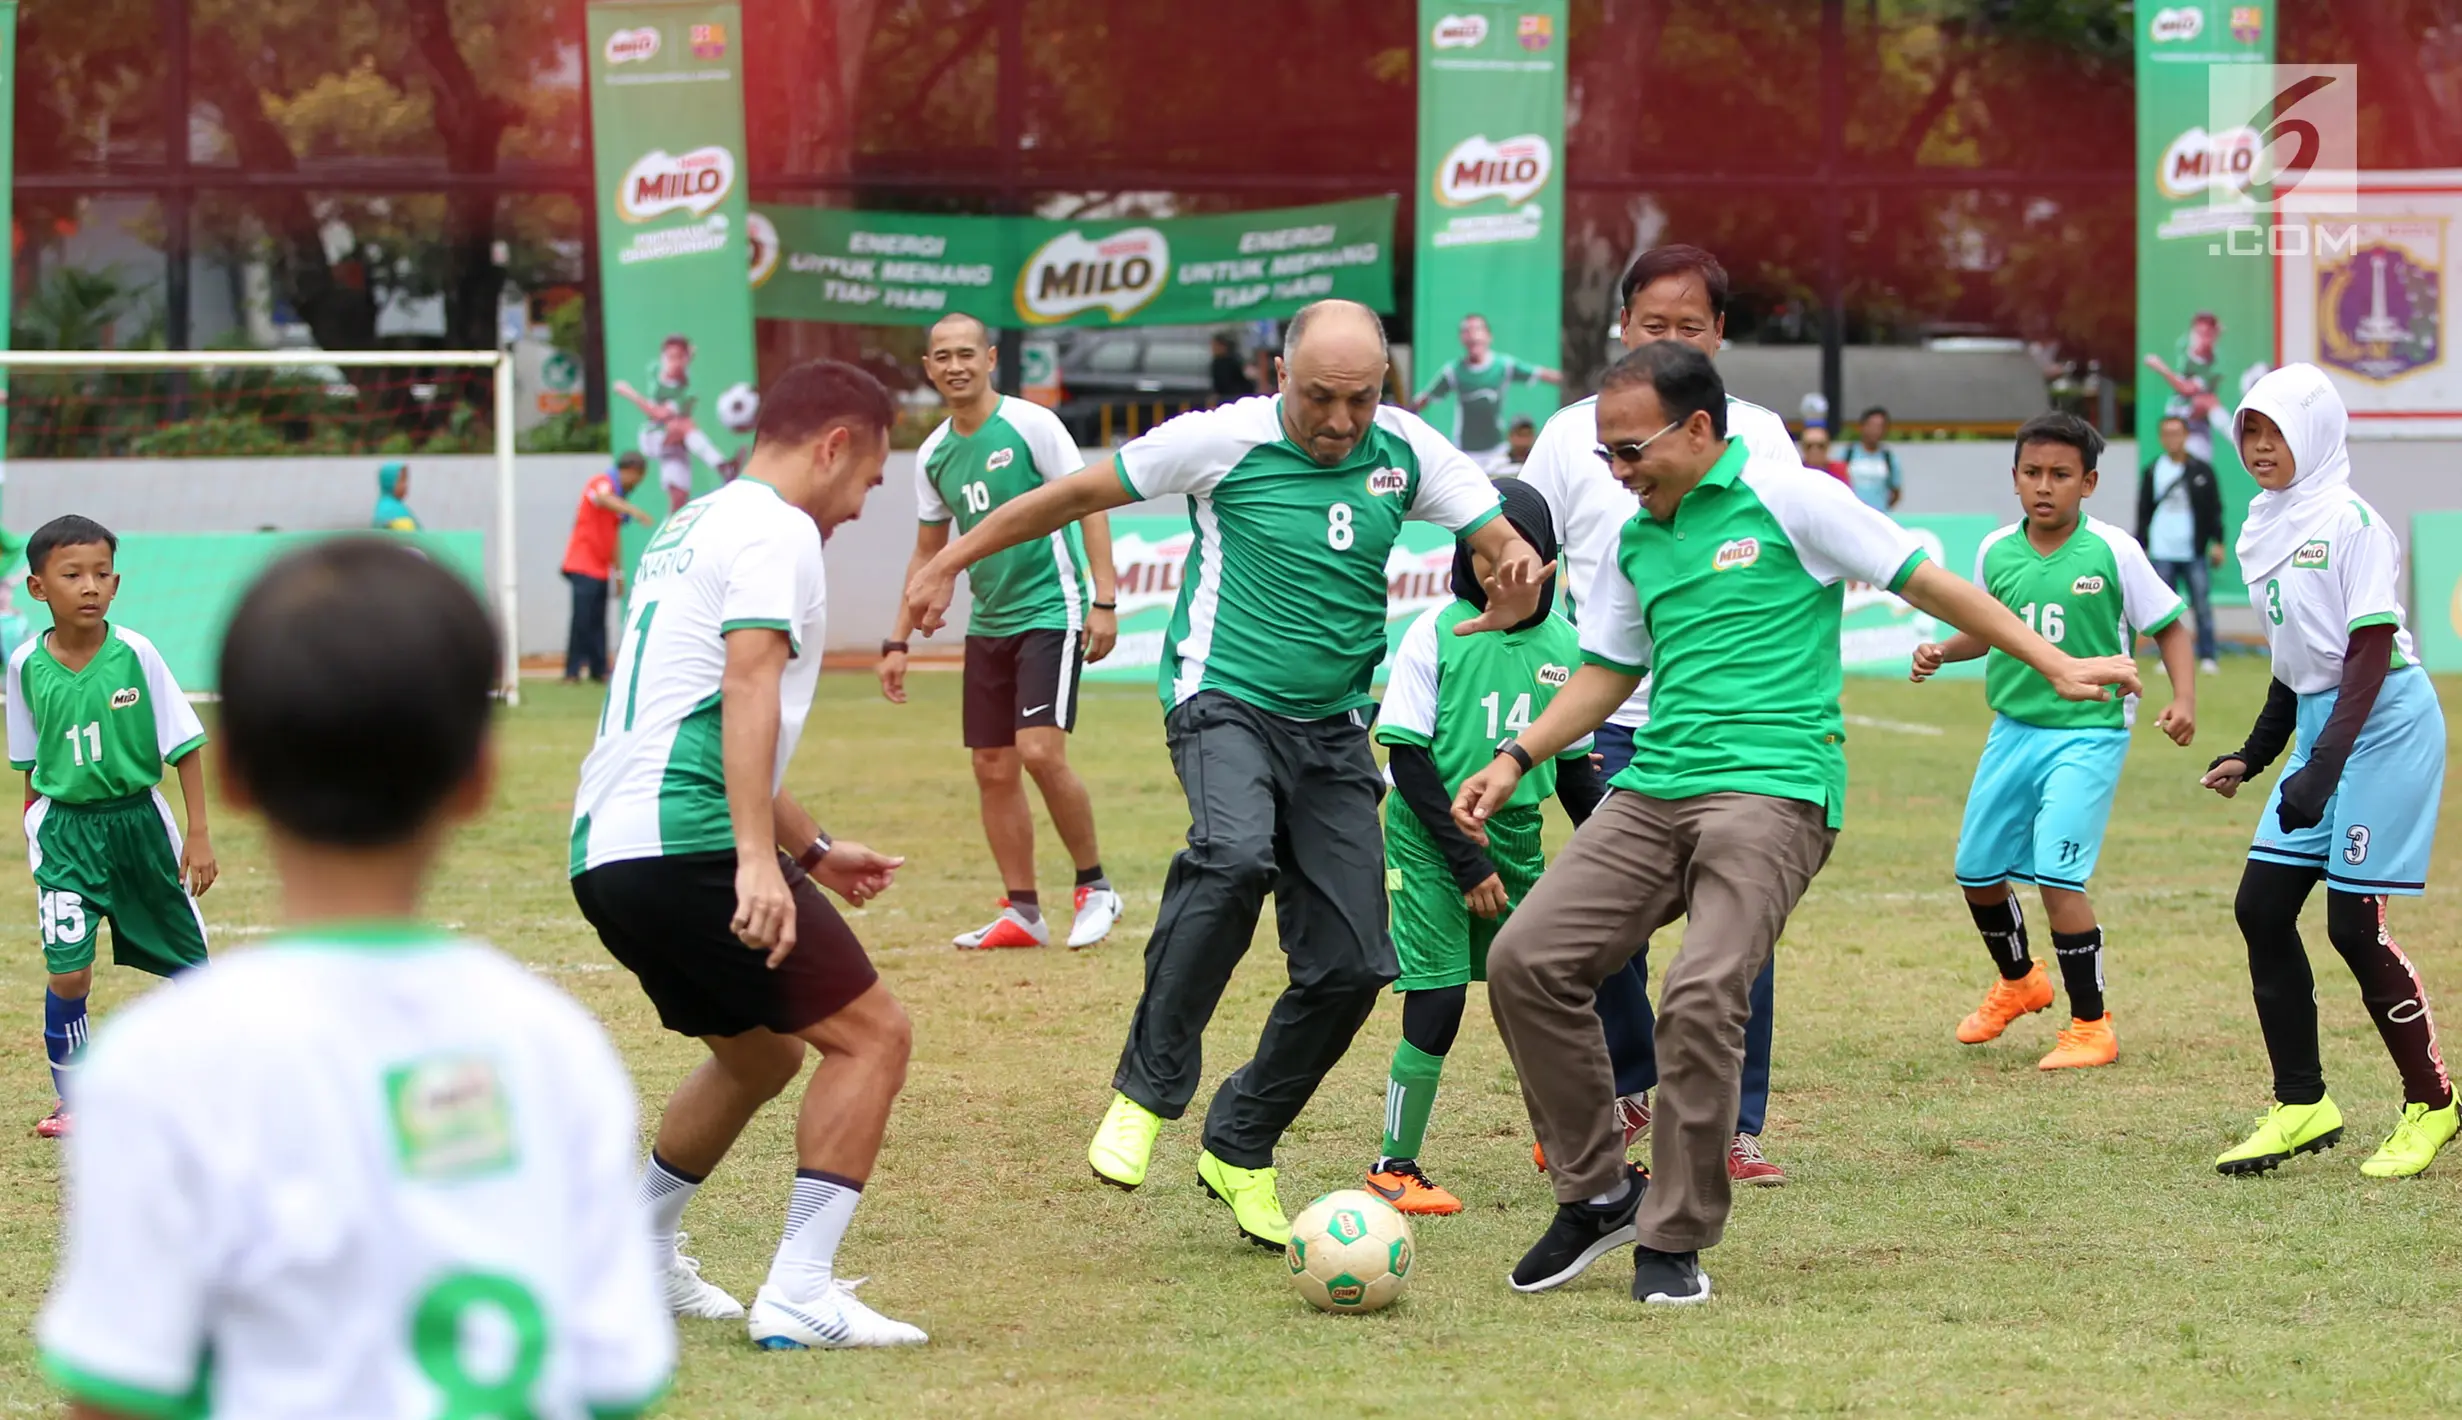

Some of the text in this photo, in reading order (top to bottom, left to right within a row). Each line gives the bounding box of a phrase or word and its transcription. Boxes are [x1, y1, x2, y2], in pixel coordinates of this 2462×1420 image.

[1451, 158, 1538, 189] MILO
[2173, 147, 2253, 181] MILO
[634, 168, 722, 206] MILO
[849, 231, 946, 257] ENERGI
[1238, 225, 1336, 253] ENERGI
[788, 253, 993, 286] UNTUK MENANG
[1038, 258, 1153, 300] MILO
[1178, 243, 1379, 284] UNTUK MENANG
[824, 279, 880, 305] TIAP
[1213, 283, 1270, 309] TIAP
[961, 480, 990, 514] 10
[1327, 502, 1354, 550] 8
[1718, 545, 1755, 563] MILO
[2298, 548, 2324, 559] MILO
[1115, 562, 1185, 595] MIL
[2076, 581, 2100, 590] MILO
[2265, 578, 2284, 625] 3
[2019, 602, 2065, 644] 16
[1540, 669, 1567, 682] MILO
[1480, 691, 1532, 739] 14
[65, 721, 102, 766] 11
[2342, 824, 2370, 866] 3
[42, 890, 87, 945] 15
